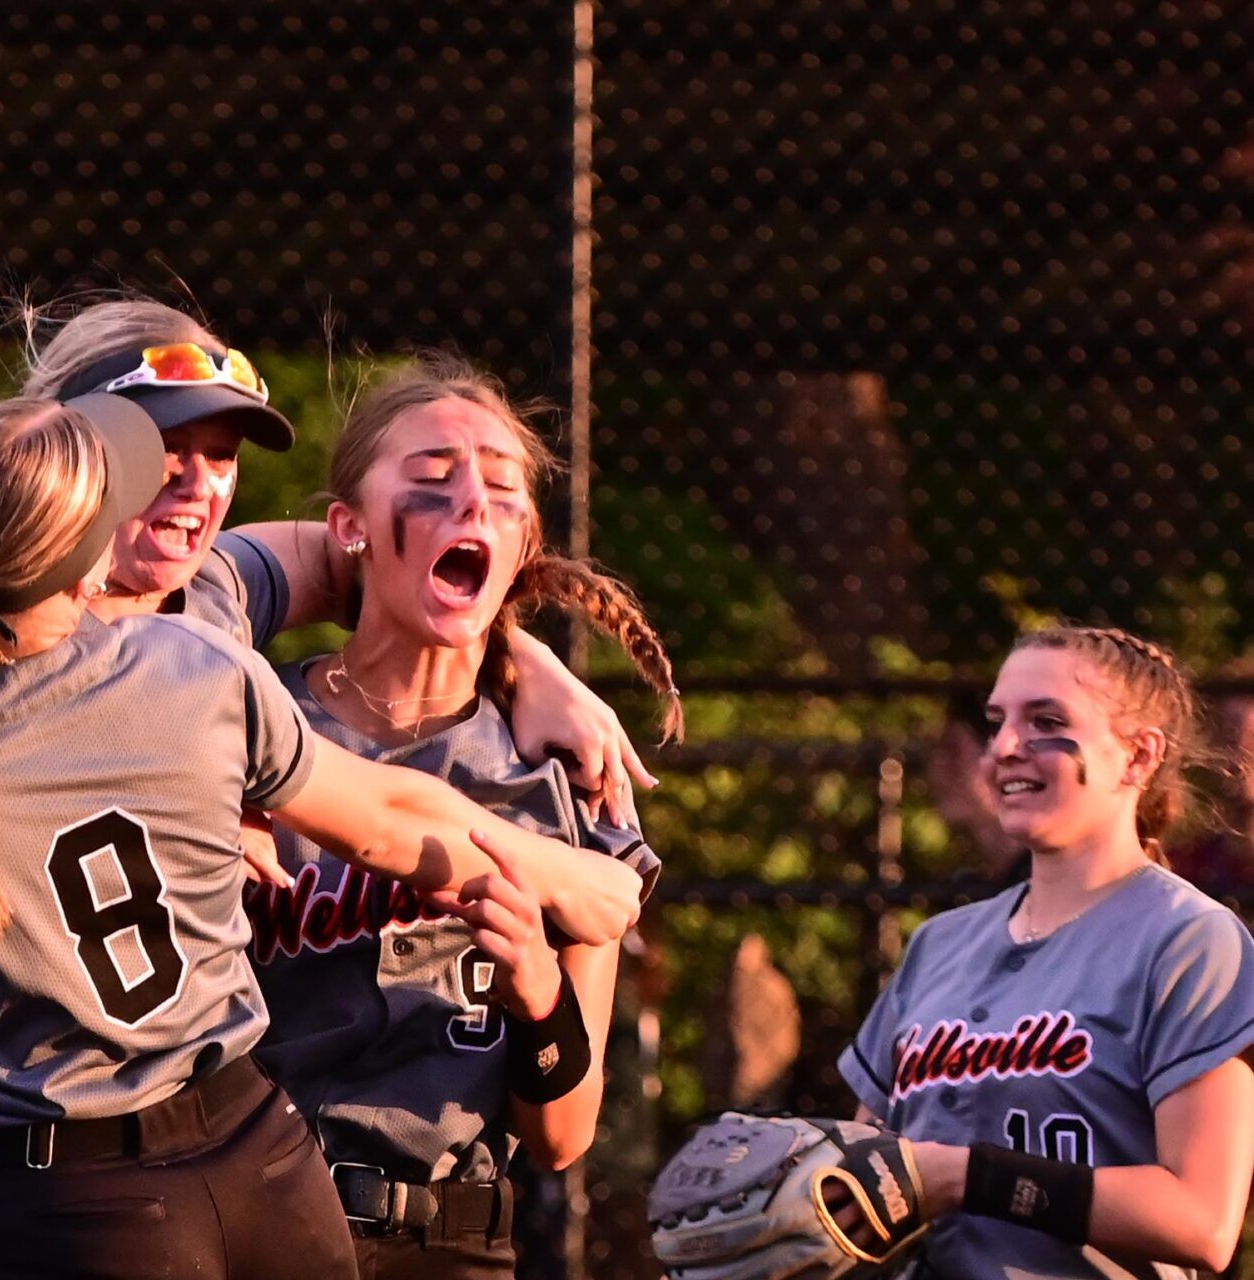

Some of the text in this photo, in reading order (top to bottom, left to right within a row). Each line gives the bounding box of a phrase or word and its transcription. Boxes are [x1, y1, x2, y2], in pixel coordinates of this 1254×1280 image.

[44, 805, 189, 1031] 8
[242, 862, 454, 966] Wells
[446, 944, 506, 1052] 9
[892, 1010, 1094, 1102] ellsville
